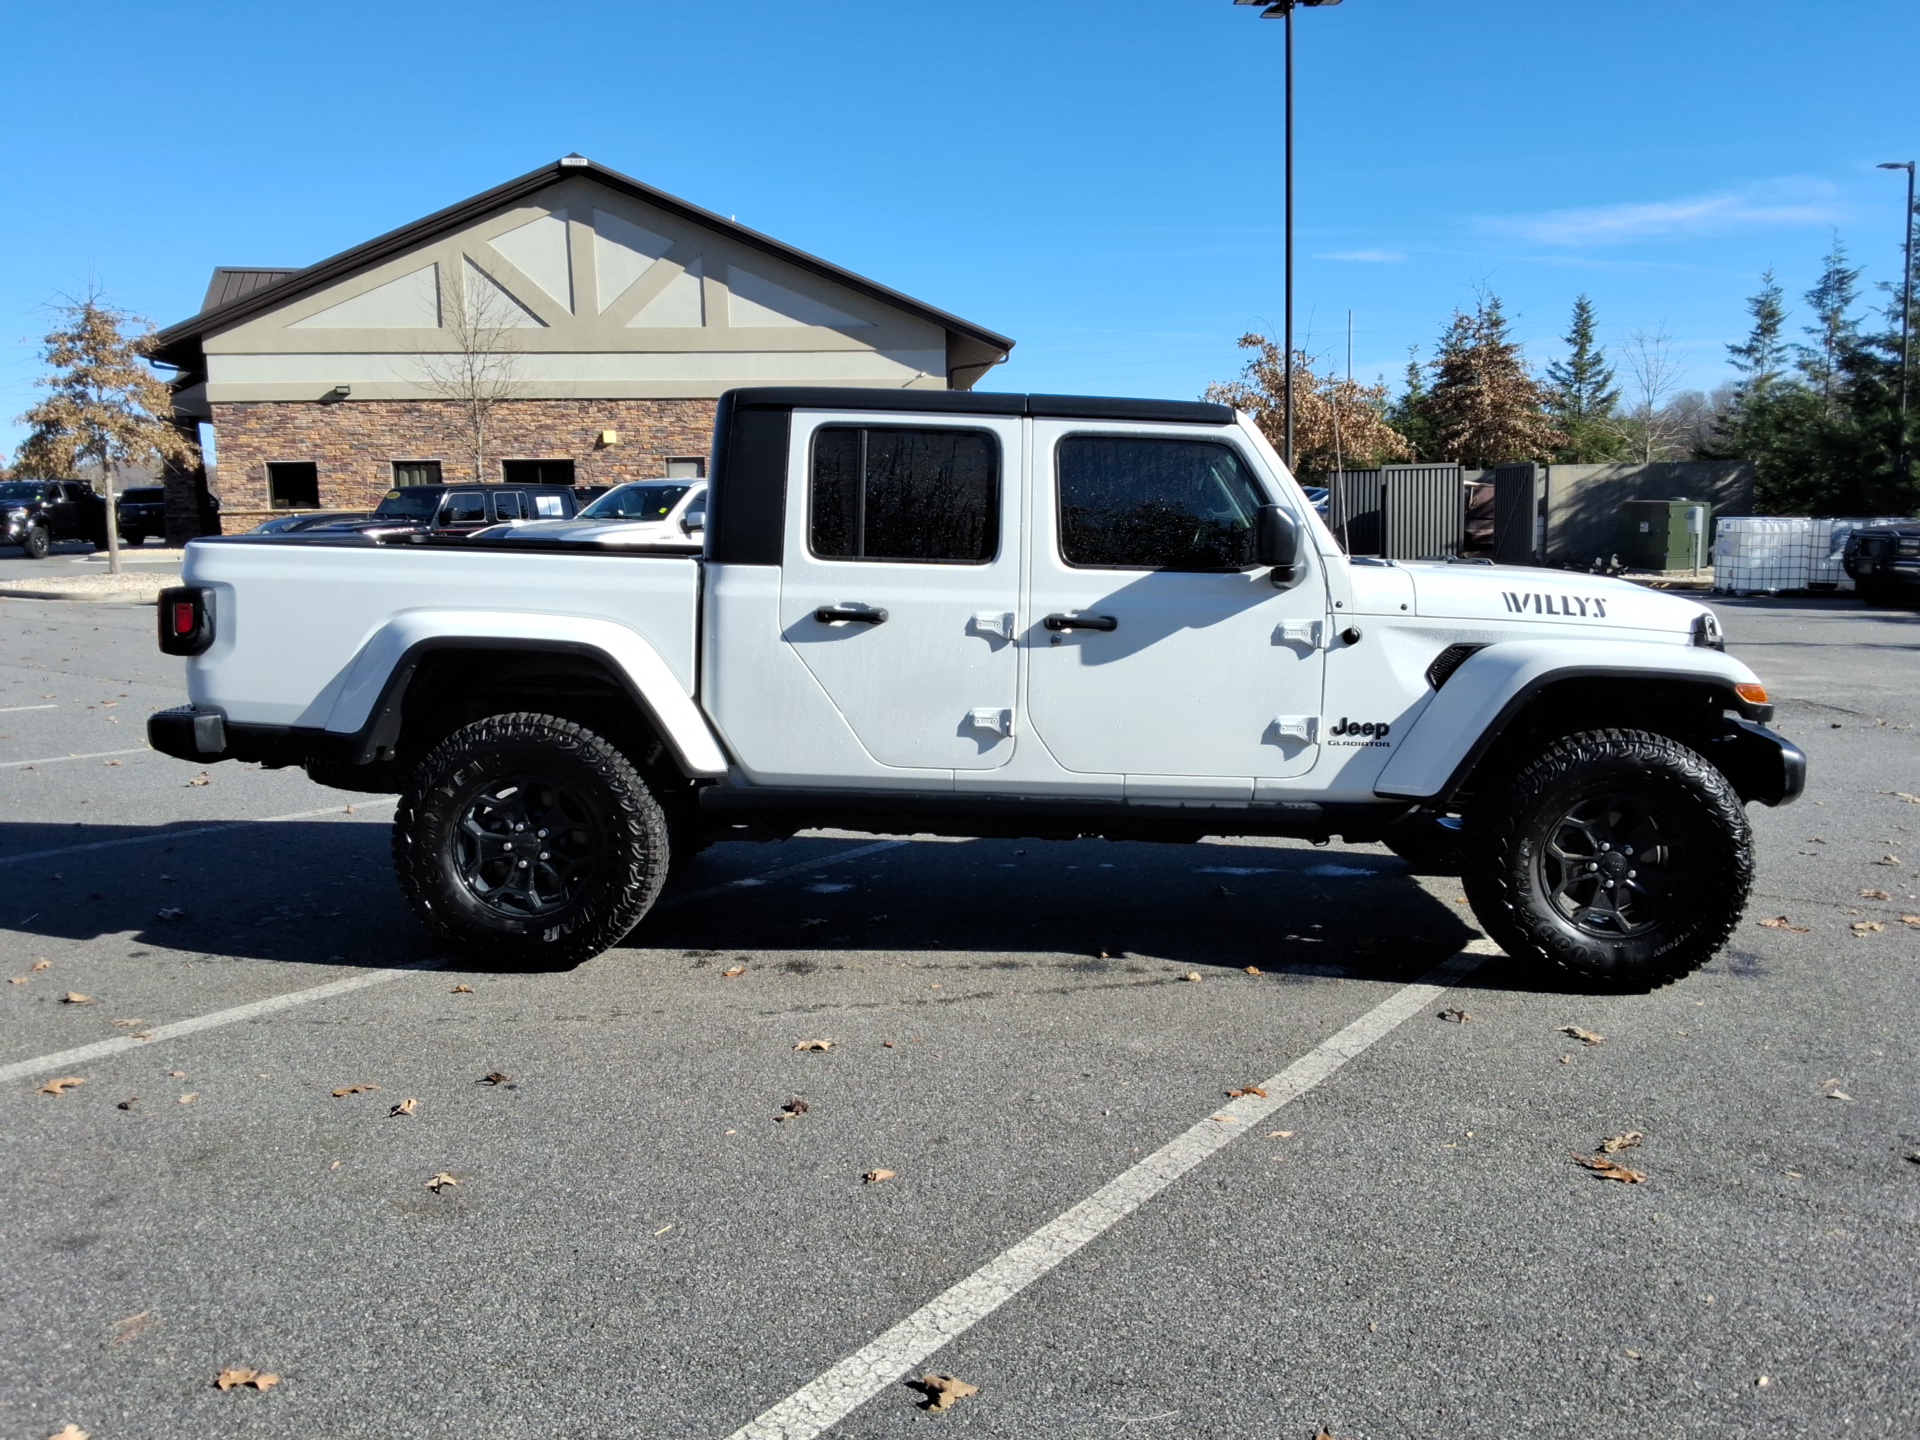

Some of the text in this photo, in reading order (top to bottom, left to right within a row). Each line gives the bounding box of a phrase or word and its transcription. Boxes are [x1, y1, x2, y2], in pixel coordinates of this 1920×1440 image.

[1501, 591, 1607, 618] WILLYS
[1332, 717, 1390, 740] Jeep
[1327, 740, 1391, 748] GLADIATOR
